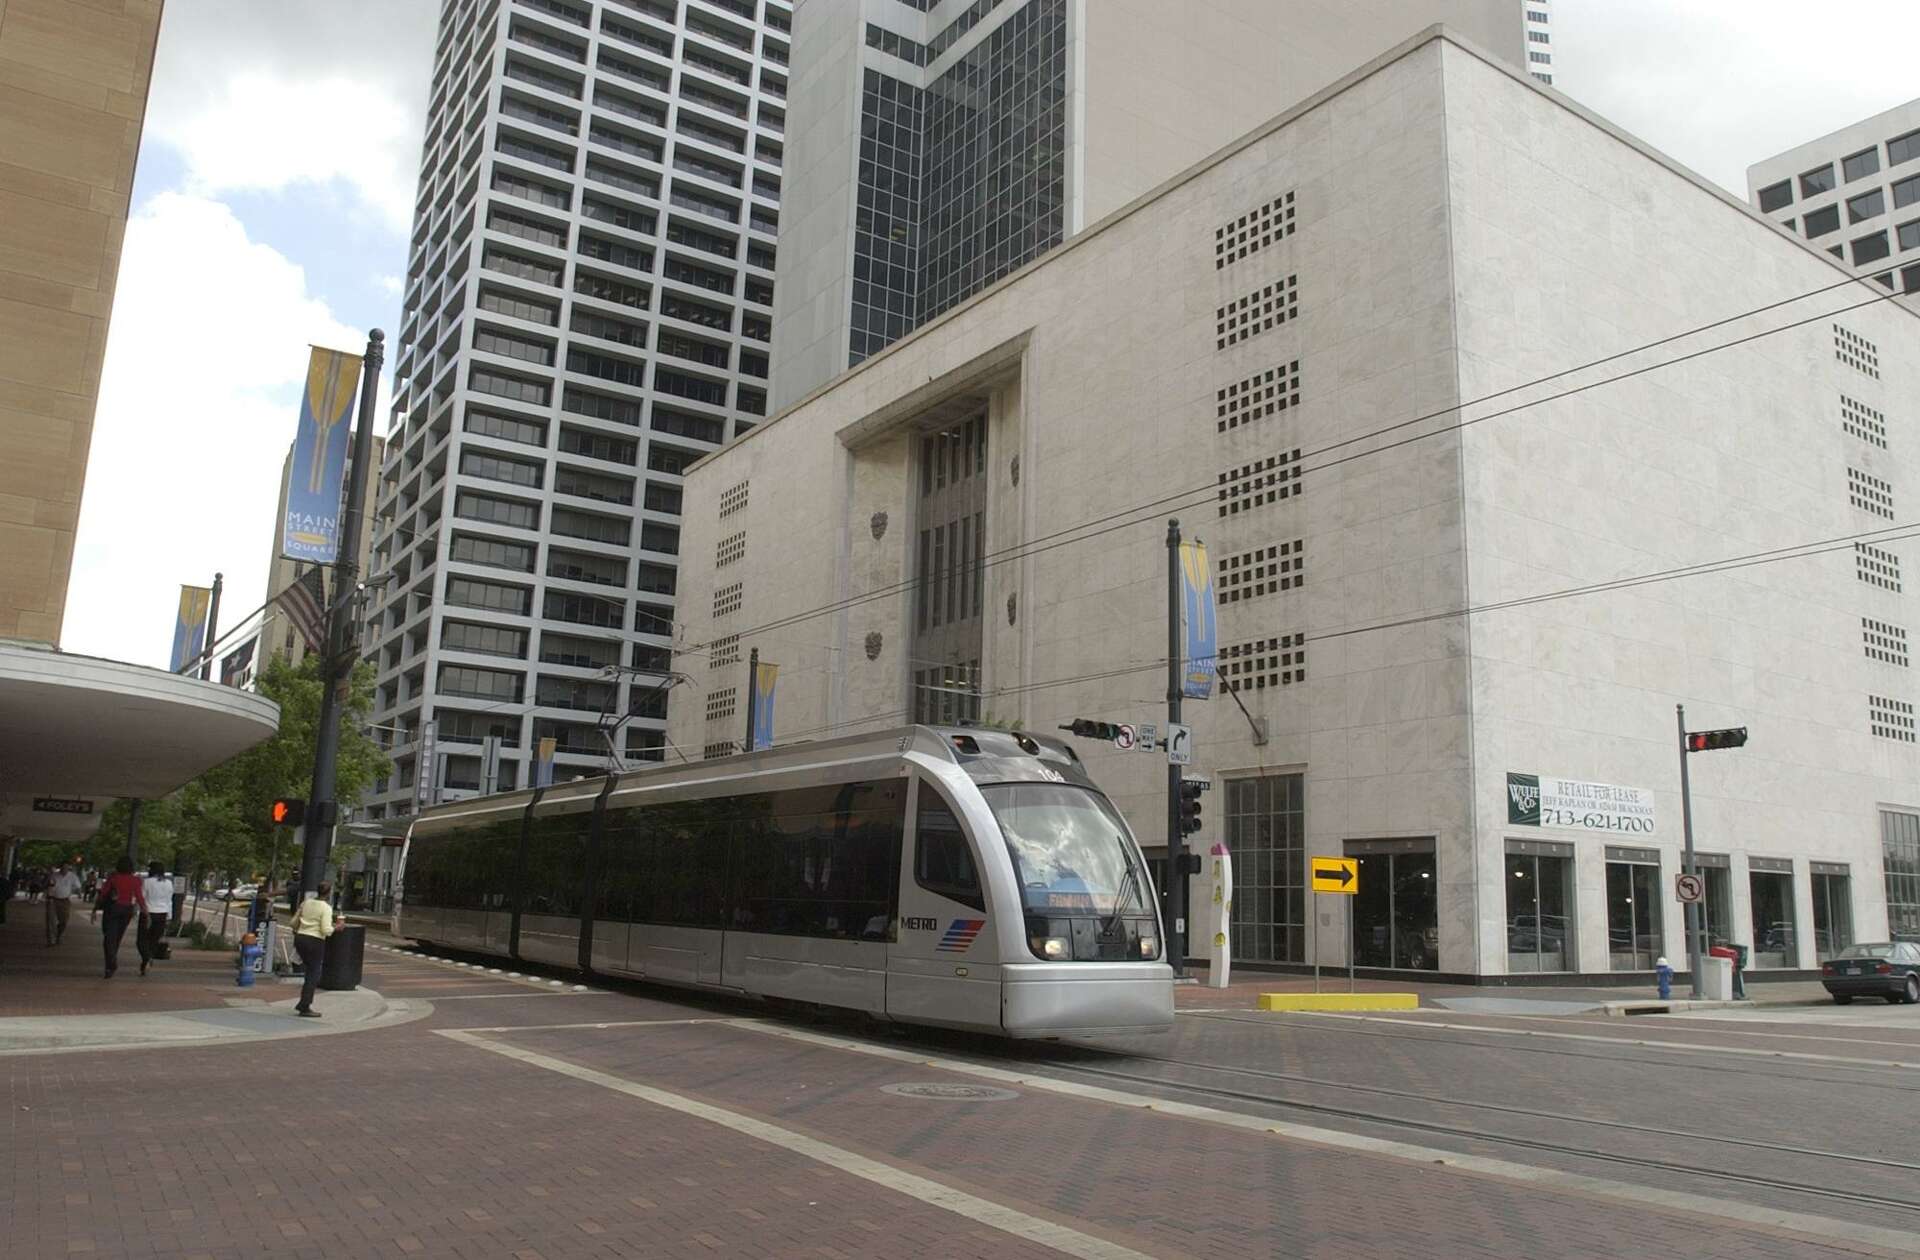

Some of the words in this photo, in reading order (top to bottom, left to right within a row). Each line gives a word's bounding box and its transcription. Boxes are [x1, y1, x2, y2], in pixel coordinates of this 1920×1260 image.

[288, 511, 336, 529] MAIN
[1170, 752, 1189, 761] ONLY
[1557, 781, 1592, 798] RETAIL
[1593, 786, 1612, 801] FOR
[1613, 787, 1640, 804] LEASE
[1542, 808, 1655, 832] 713-621-1700
[901, 917, 937, 931] METRO
